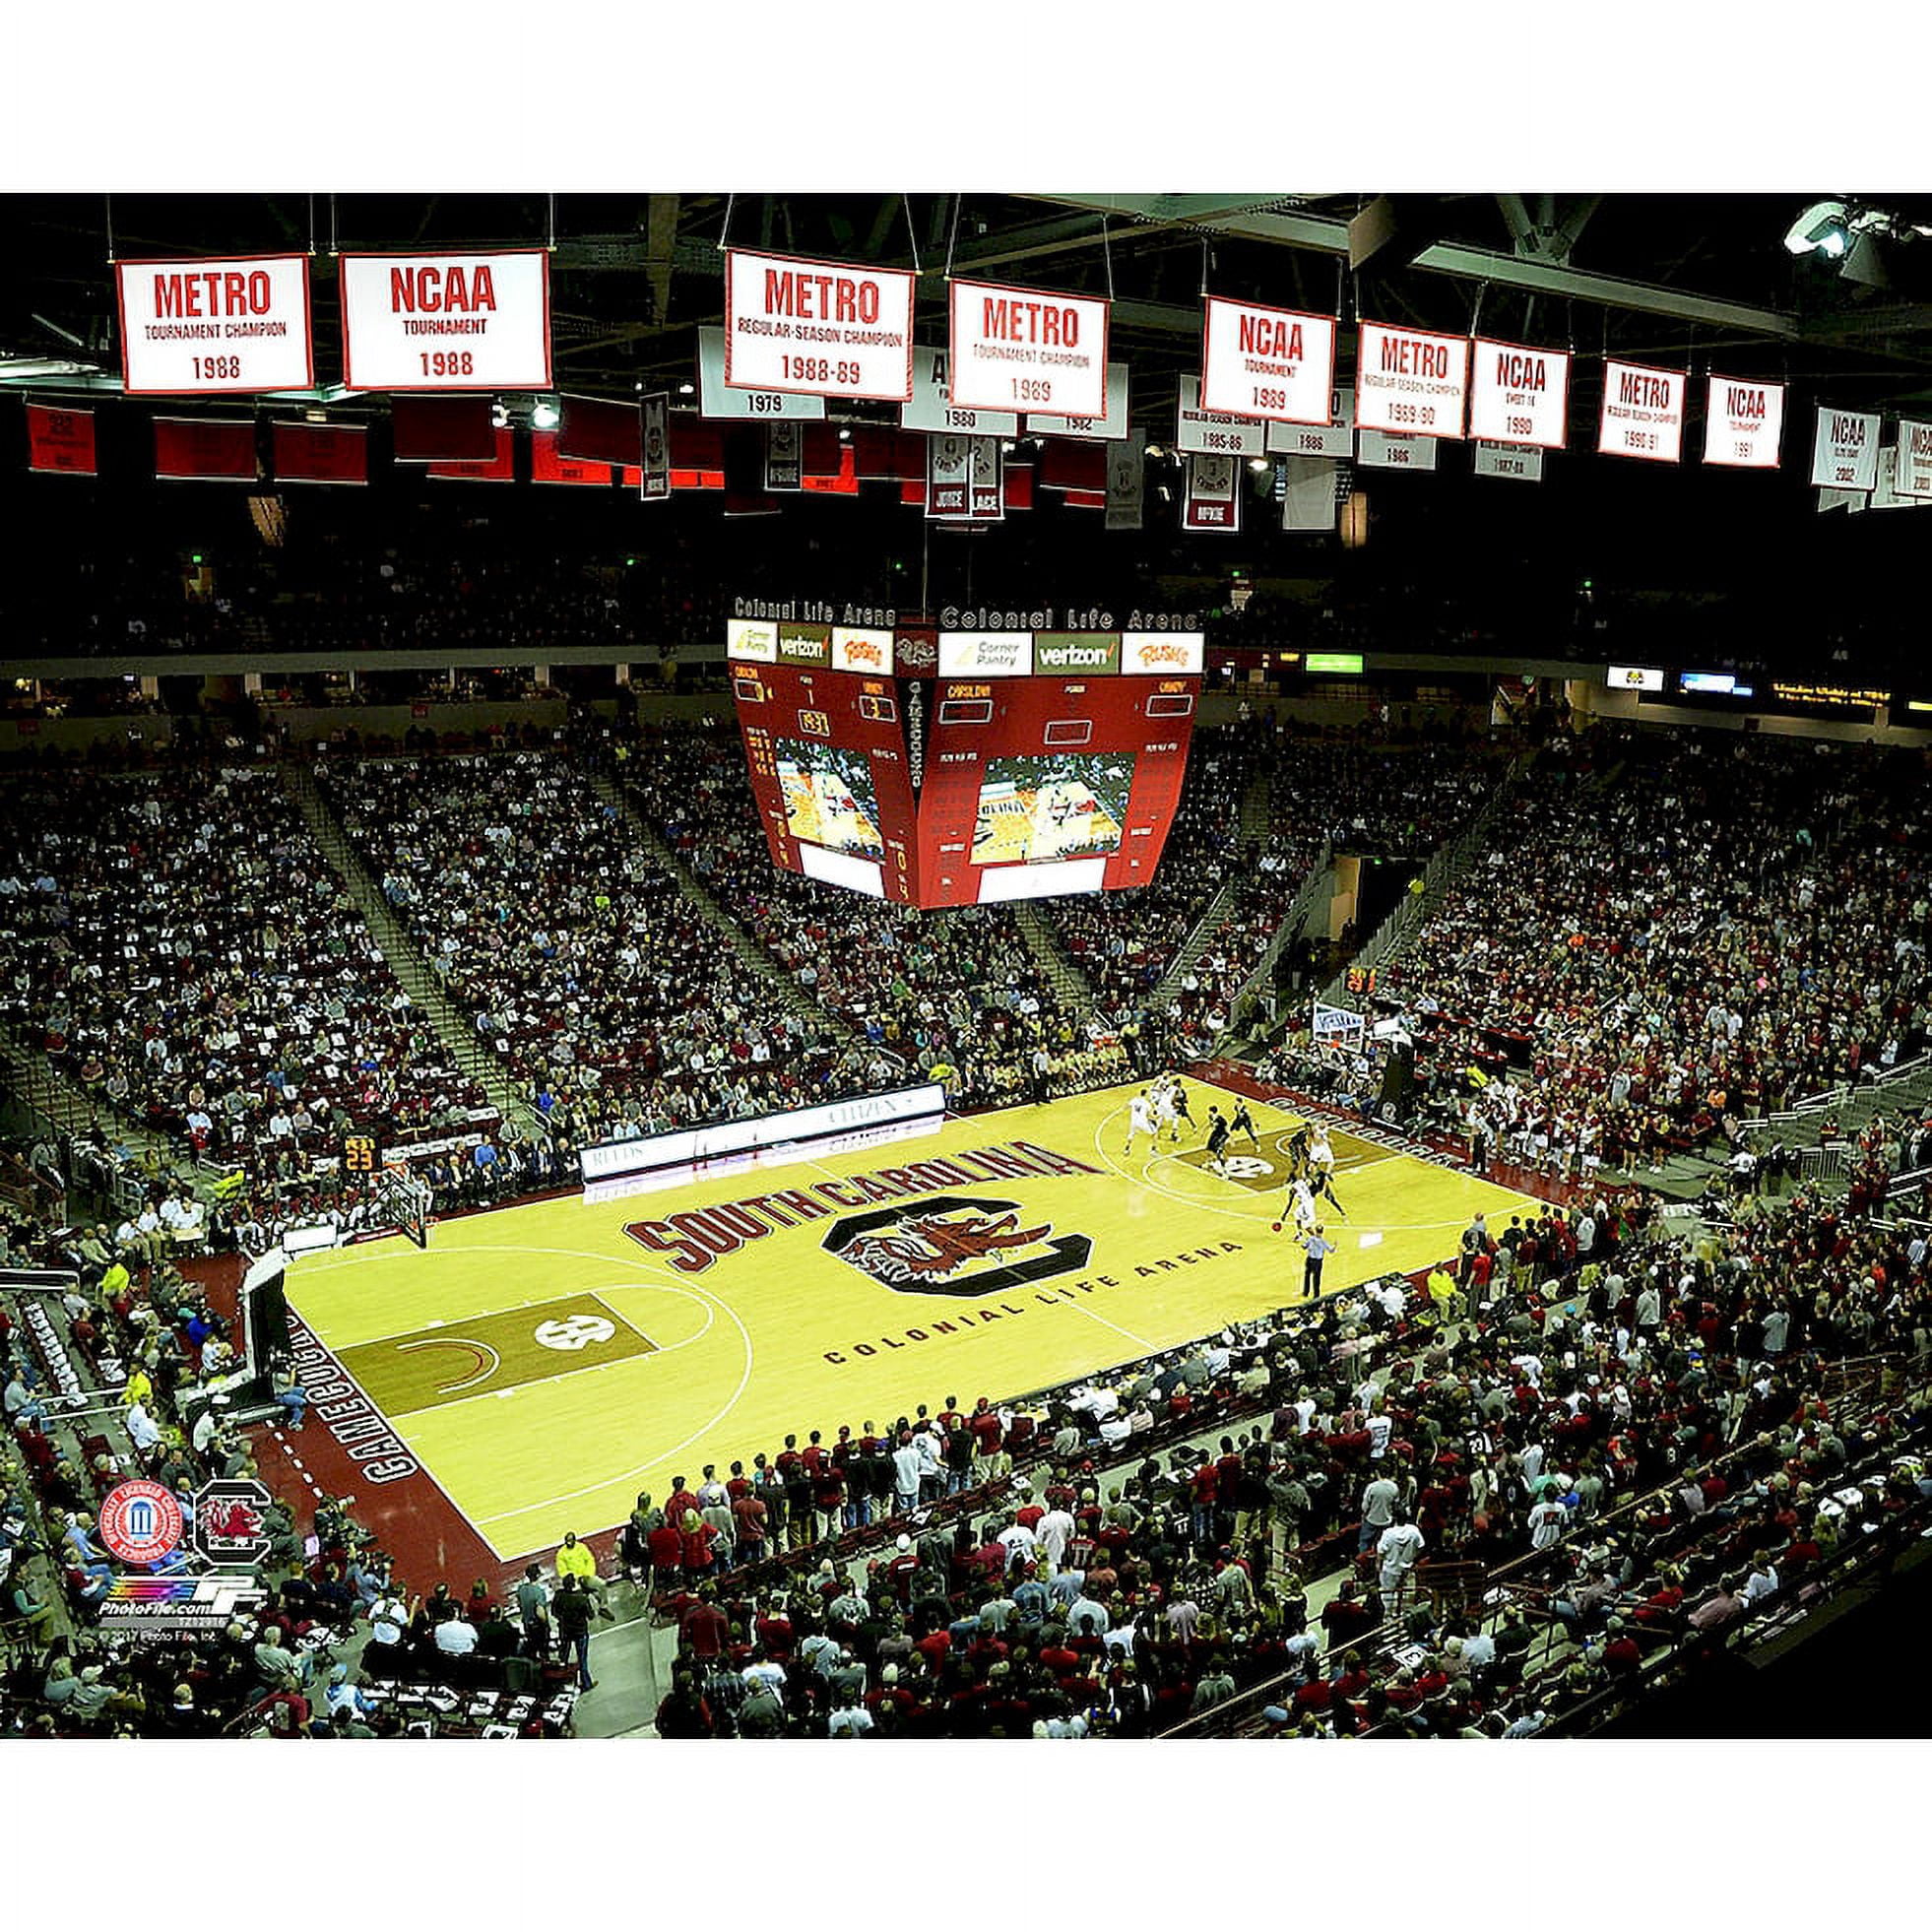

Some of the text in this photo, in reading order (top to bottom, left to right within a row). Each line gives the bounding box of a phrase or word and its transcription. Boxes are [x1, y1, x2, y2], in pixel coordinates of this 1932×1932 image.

[155, 271, 271, 318] METRO
[391, 266, 496, 312] NCAA
[765, 269, 879, 324] METRO
[145, 321, 287, 340] TOURNAMENT CHAMPION
[403, 318, 488, 335] TOURNAMENT
[983, 297, 1078, 348] METRO
[844, 331, 903, 348] CHAMPION
[1240, 315, 1303, 362] NCAA
[419, 351, 474, 376] 1988
[973, 344, 1037, 363] TOURNAMENT
[1381, 336, 1449, 379] METRO
[192, 355, 240, 379] 1988
[781, 355, 860, 384] 1988-89
[1497, 353, 1546, 392] NCAA
[1010, 378, 1051, 402] 1989
[1254, 387, 1286, 410] 1989
[1620, 371, 1670, 410] METRO
[1726, 386, 1766, 419] NCAA
[747, 395, 782, 412] 1979
[1831, 414, 1865, 446] NCAA
[735, 597, 896, 626] Colonial Life Arena
[940, 606, 1198, 630] Colonial Life Arena
[780, 633, 823, 659] verizon
[978, 641, 1019, 654] Corner
[1040, 645, 1107, 667] verizon
[977, 654, 1018, 667] Pantry
[347, 1150, 373, 1170] 23
[623, 1141, 1105, 1275] SOUTH CAROLINA
[823, 1241, 1243, 1366] COLONIAL LIFE ARENA
